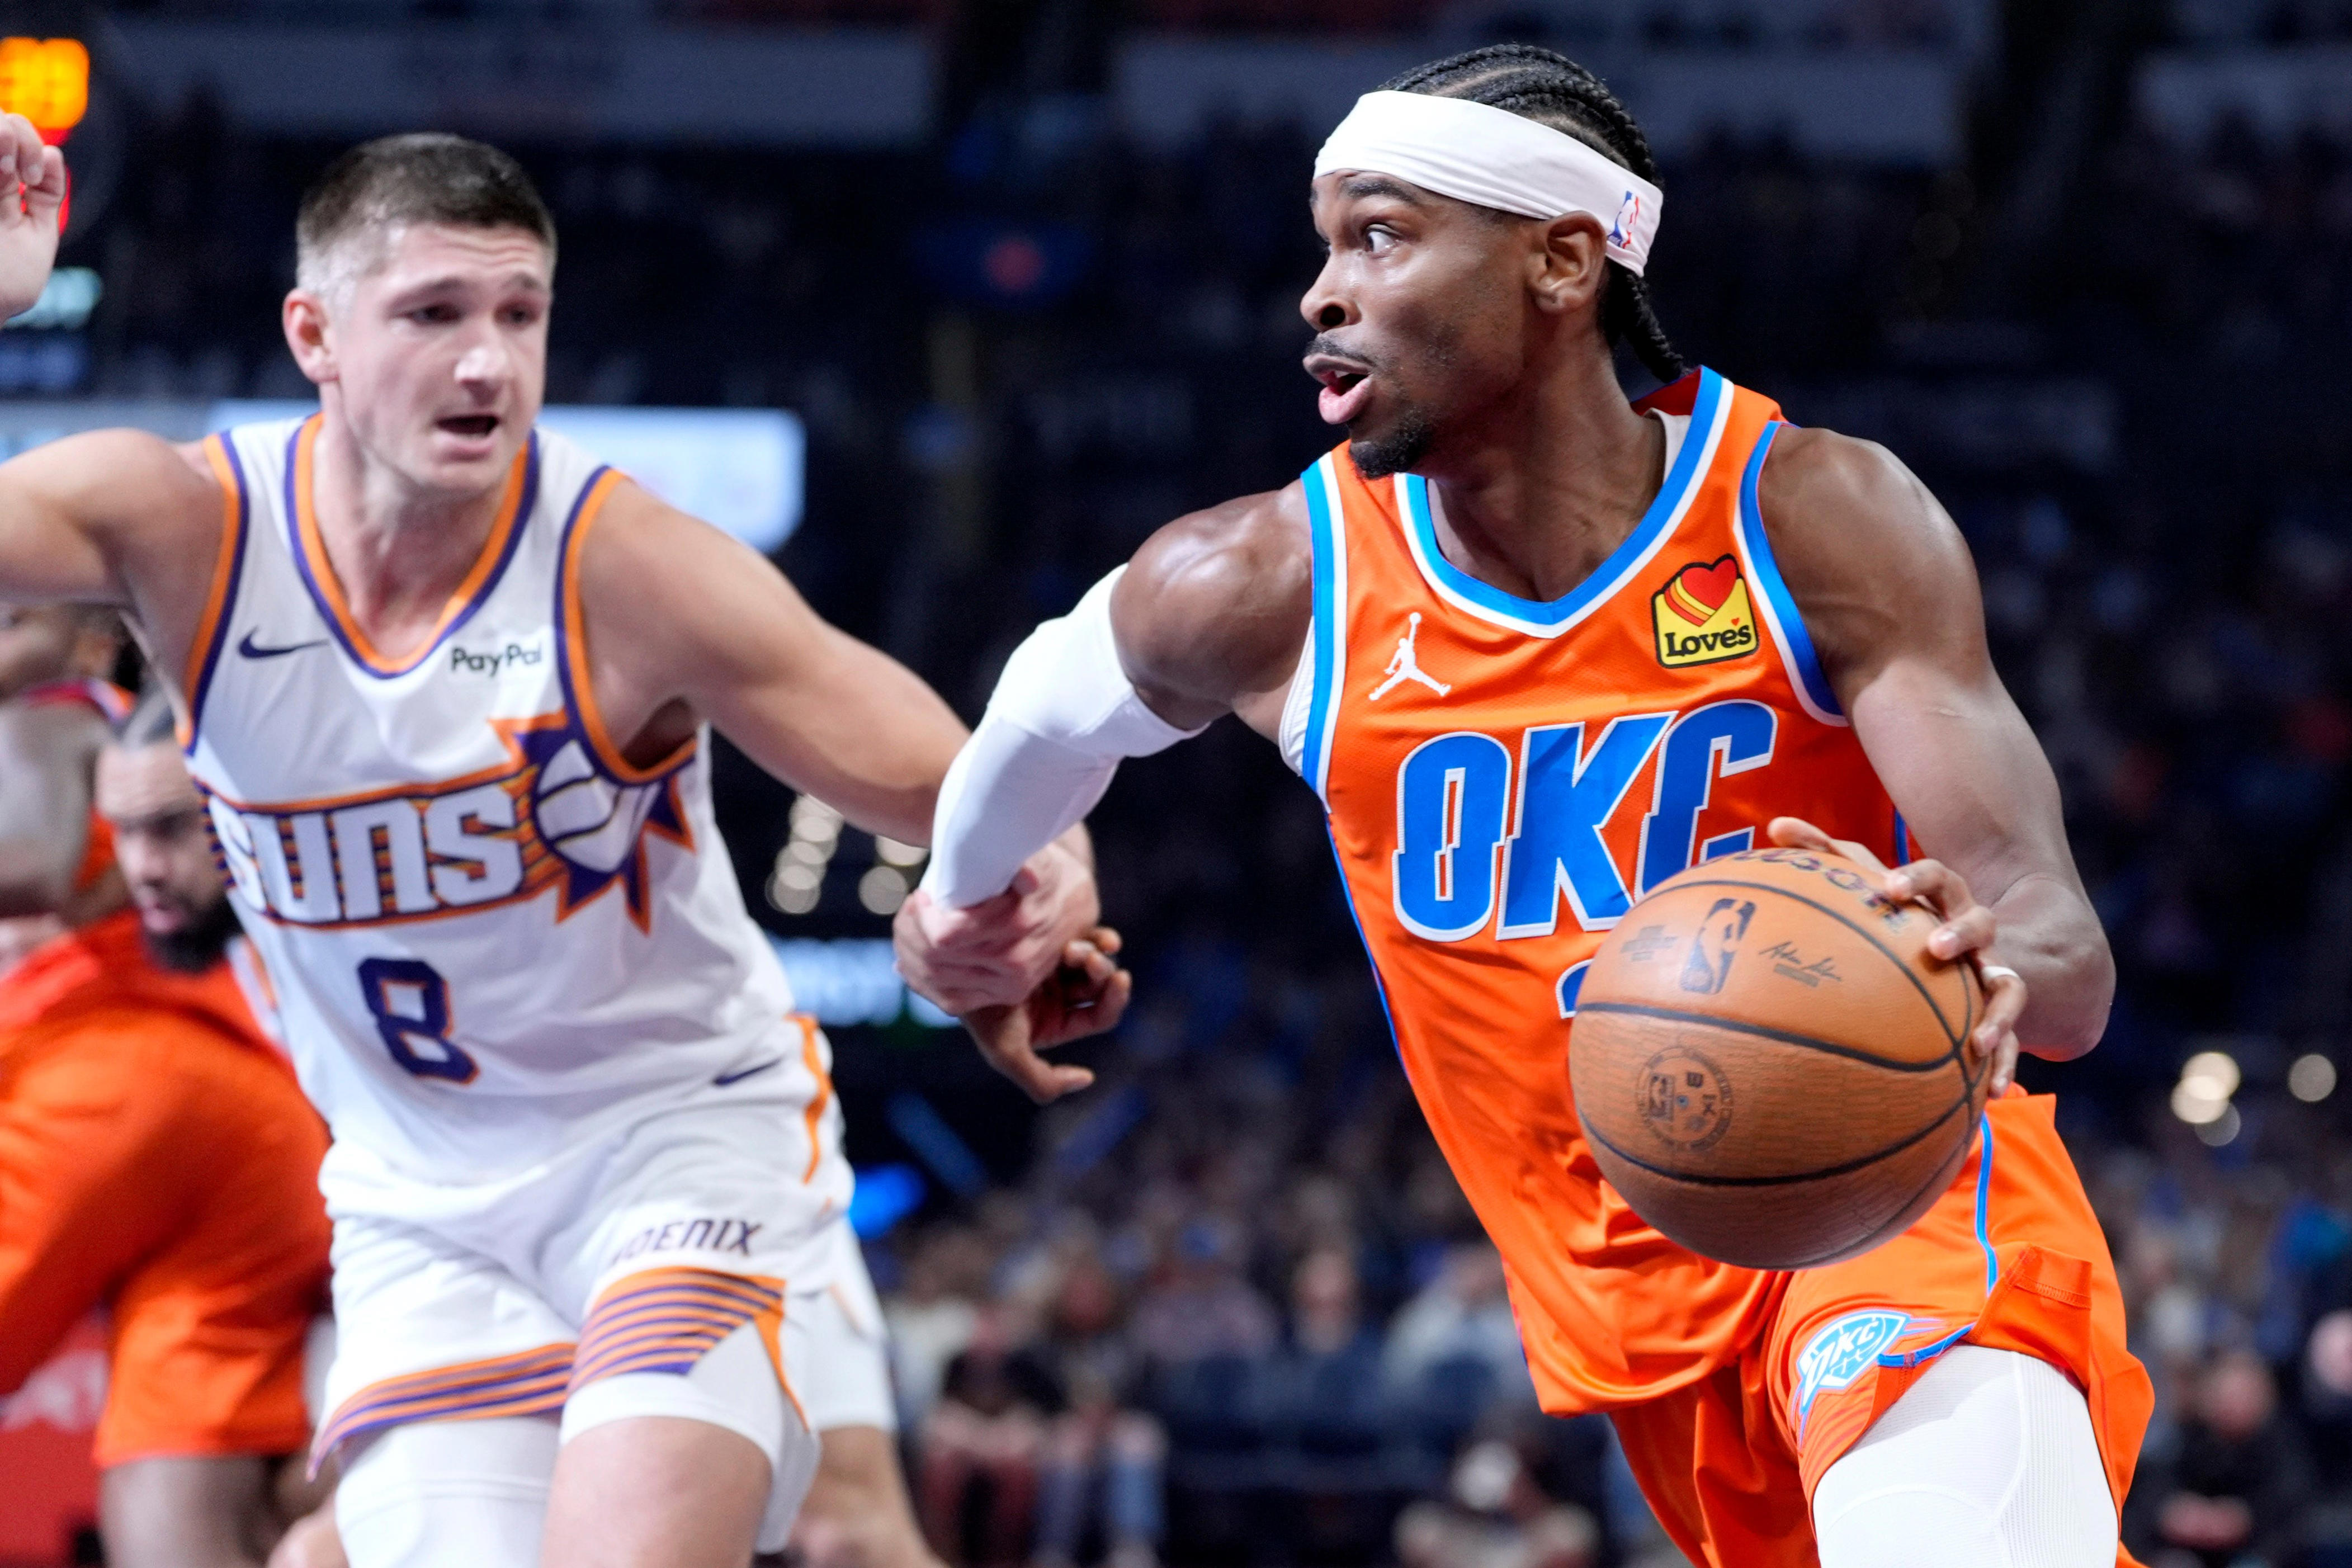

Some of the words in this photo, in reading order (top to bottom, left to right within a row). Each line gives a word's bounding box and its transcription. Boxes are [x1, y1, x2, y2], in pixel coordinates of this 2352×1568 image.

[451, 643, 542, 677] PayPal
[1391, 698, 1779, 942] OKC
[358, 957, 480, 1084] 8
[1802, 1320, 1879, 1407] OKC
